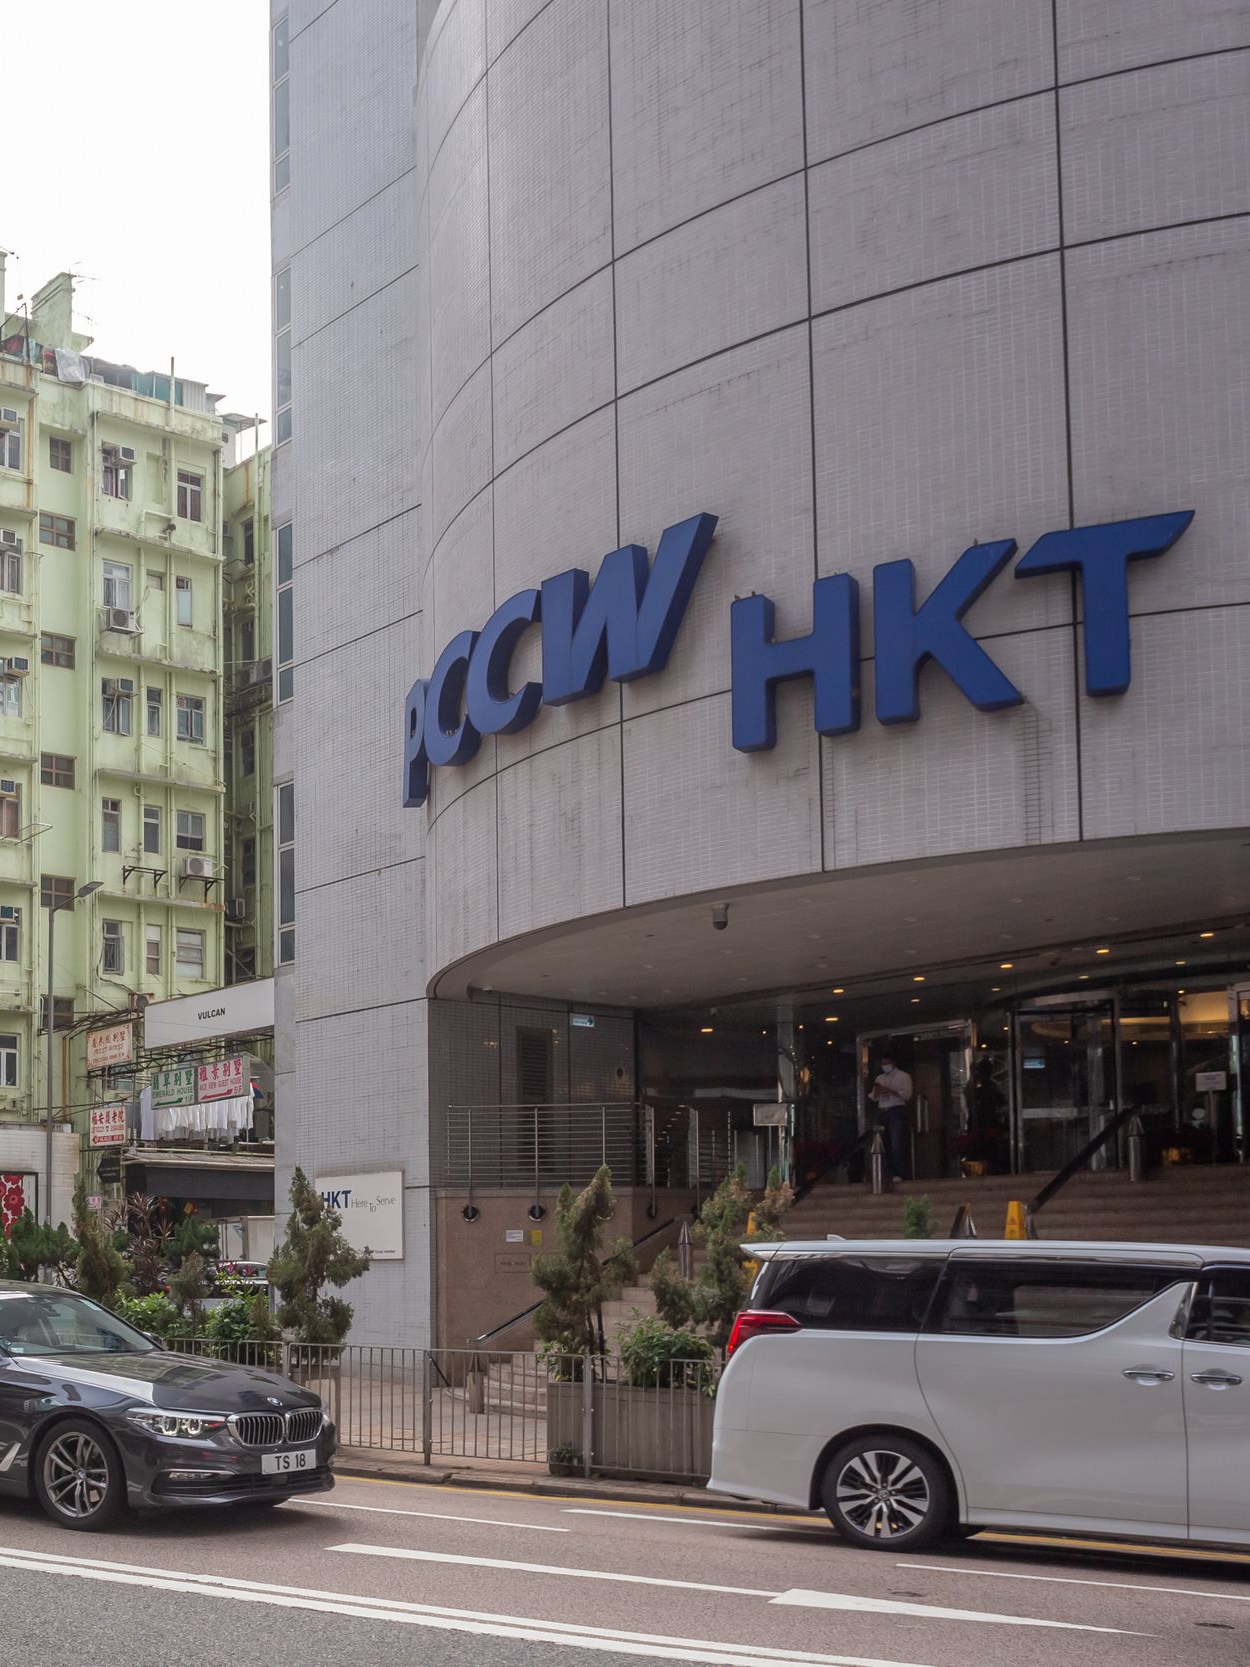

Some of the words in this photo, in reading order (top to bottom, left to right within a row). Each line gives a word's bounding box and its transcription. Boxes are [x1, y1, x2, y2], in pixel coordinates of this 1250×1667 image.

[403, 512, 718, 808] PCCW
[730, 509, 1195, 753] HKT
[198, 1008, 226, 1021] VULCAN
[198, 1058, 242, 1082] 雅景別墅
[153, 1087, 175, 1098] EMERALD
[176, 1085, 194, 1095] HOUSE
[218, 1079, 229, 1088] GUEST
[321, 1190, 352, 1209] HKT
[352, 1198, 368, 1208] Here
[369, 1203, 376, 1212] To
[376, 1196, 396, 1205] Serve
[275, 1455, 290, 1470] TS
[295, 1453, 306, 1469] 18
